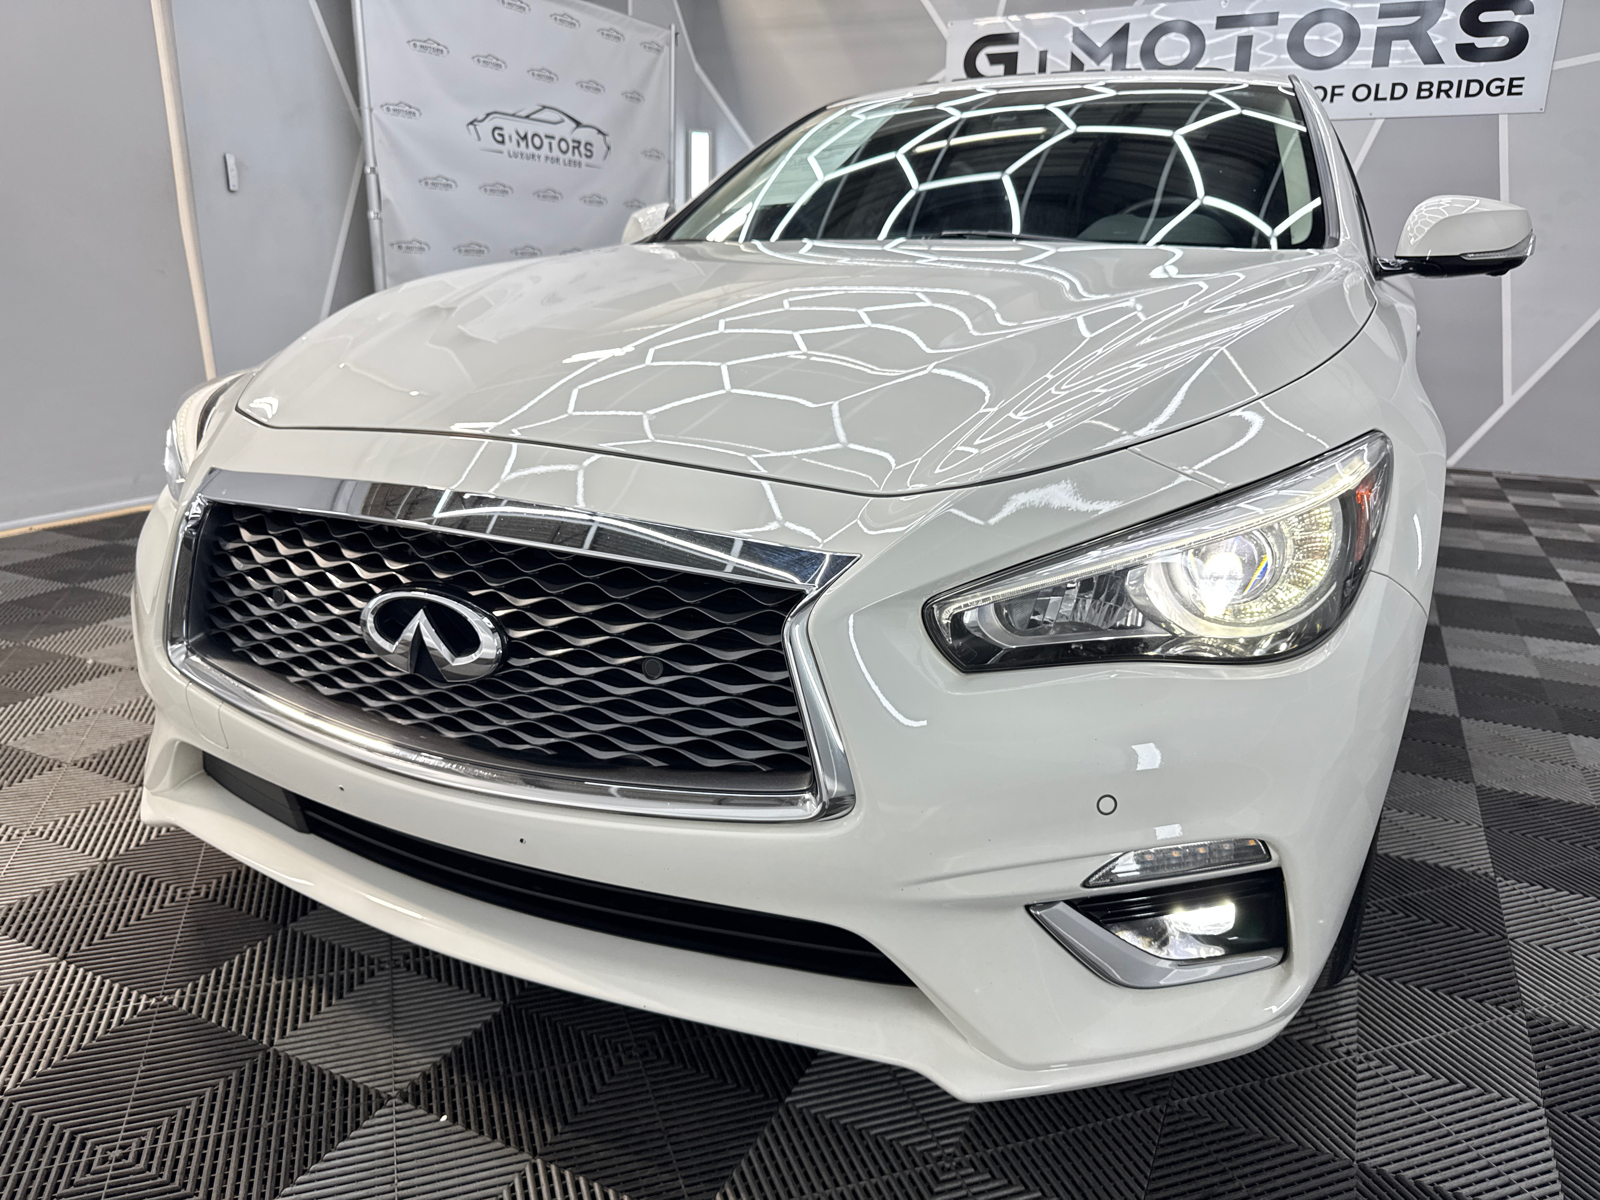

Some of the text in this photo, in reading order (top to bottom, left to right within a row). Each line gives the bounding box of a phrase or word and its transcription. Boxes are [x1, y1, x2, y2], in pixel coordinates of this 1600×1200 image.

[1351, 82, 1408, 102] OLD
[1415, 76, 1525, 100] BRIDGE
[514, 129, 594, 159] MOTORS
[507, 150, 541, 163] LUXURY
[562, 158, 582, 169] LESS
